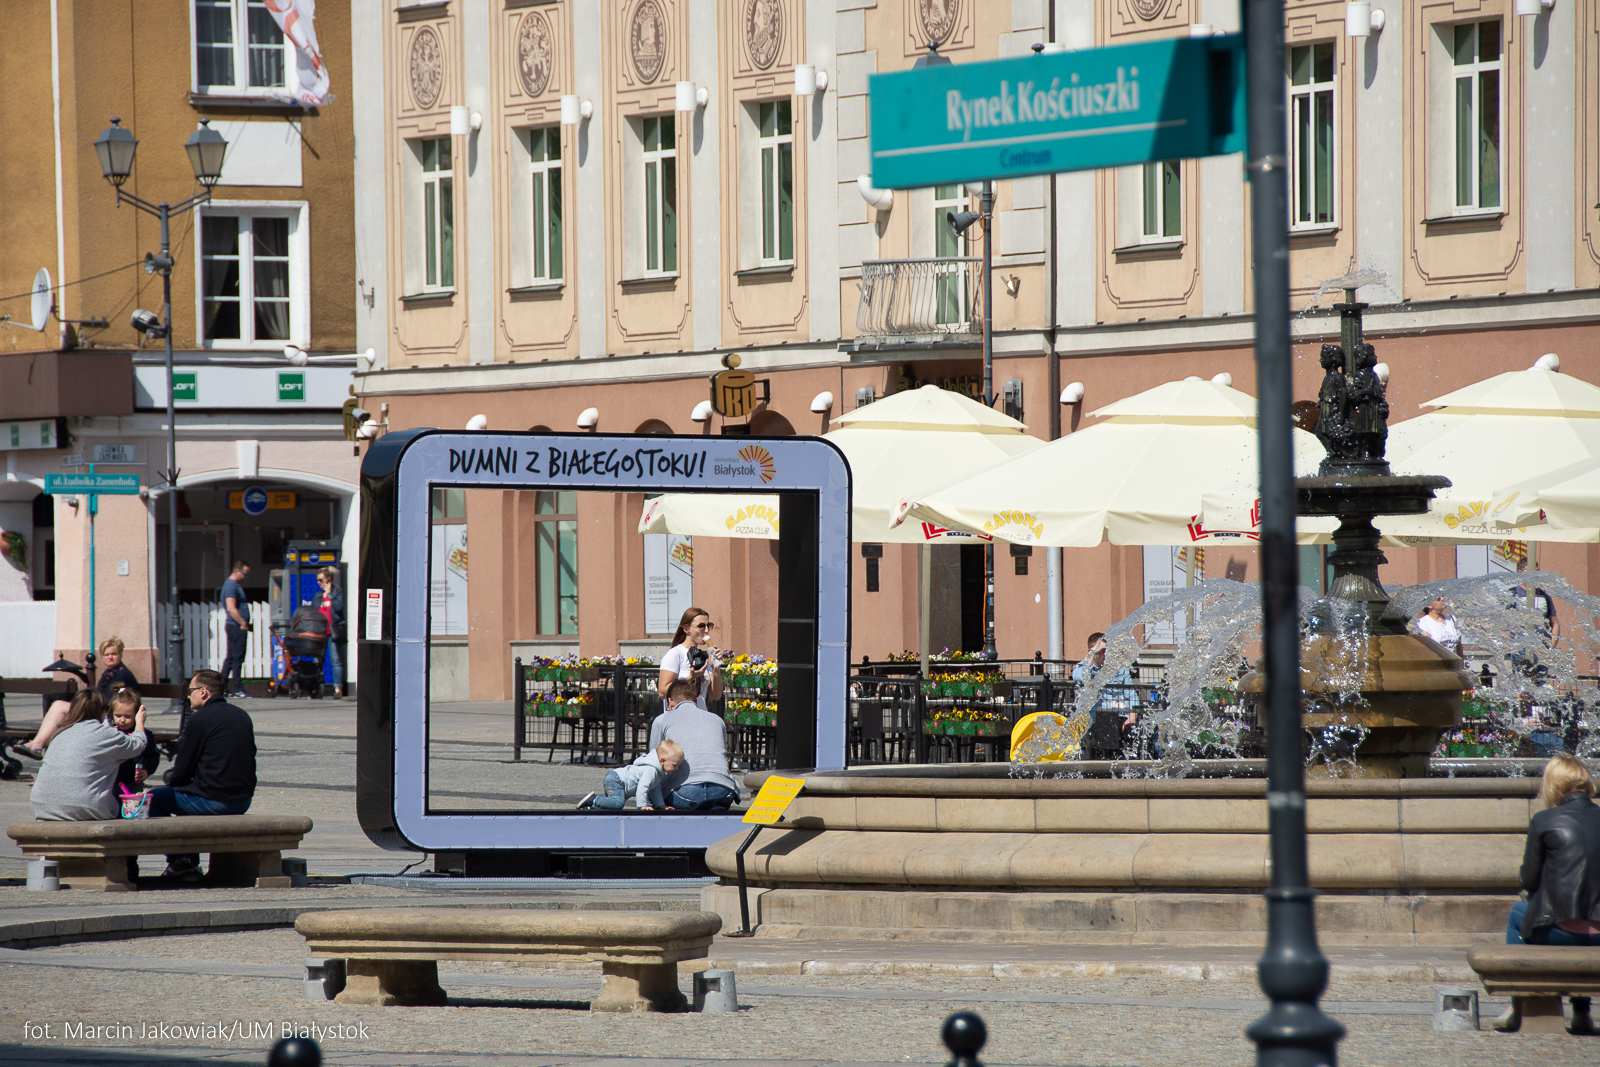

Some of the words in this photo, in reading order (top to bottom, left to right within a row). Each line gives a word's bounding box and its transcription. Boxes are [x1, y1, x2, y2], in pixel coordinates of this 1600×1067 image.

[946, 80, 1015, 142] Rynek
[1017, 66, 1141, 122] Kościuszki
[1000, 147, 1052, 168] Centrum
[449, 448, 518, 475] DUMNI
[526, 451, 541, 474] Z
[548, 447, 708, 478] BIAŁEGOSTOKU!
[714, 464, 756, 478] Białystok
[96, 476, 137, 486] Zamenhofa
[735, 526, 754, 534] PIZZA
[754, 527, 770, 535] CLUB
[1461, 525, 1489, 534] PIZZA
